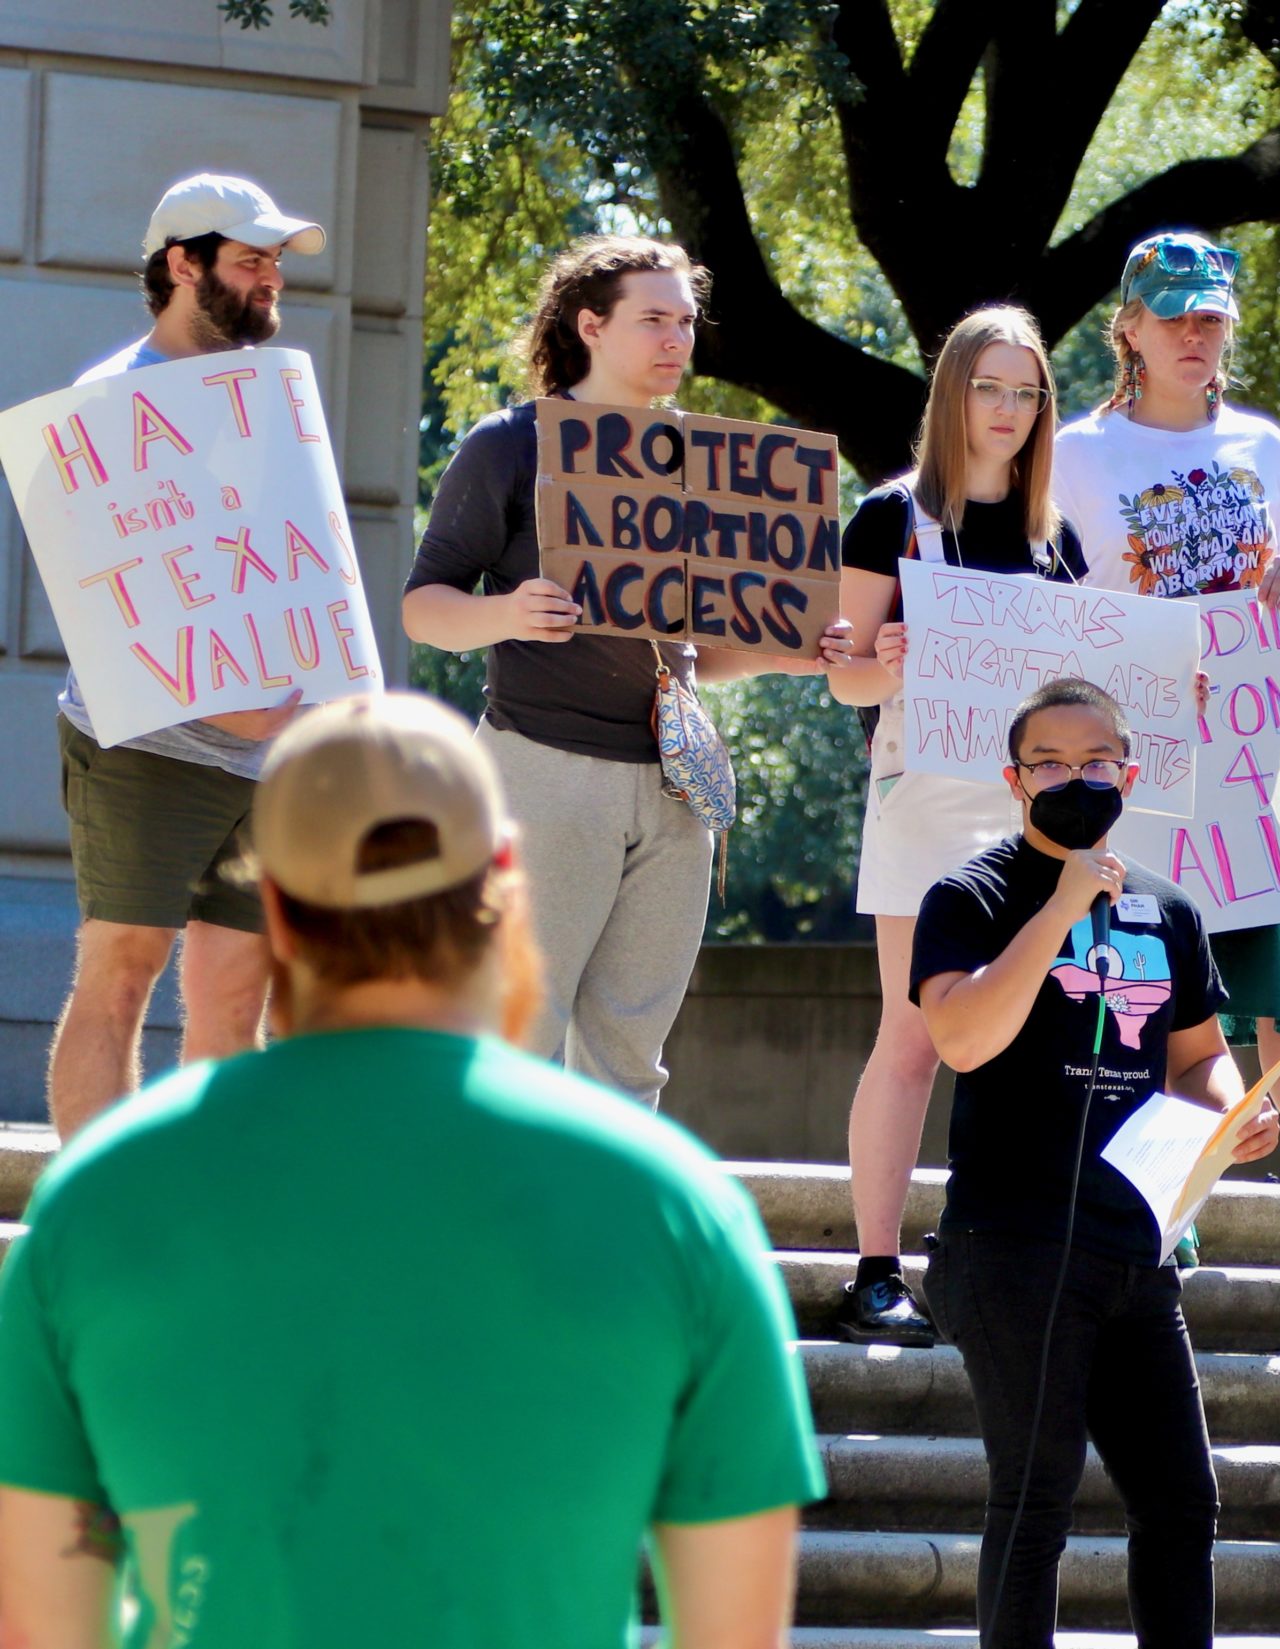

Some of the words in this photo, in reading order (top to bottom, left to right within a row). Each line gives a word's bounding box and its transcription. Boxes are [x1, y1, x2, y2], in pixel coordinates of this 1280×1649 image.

[41, 368, 321, 494] HATE
[559, 412, 836, 505] PROTECT
[107, 479, 195, 538] isn't
[220, 485, 242, 511] a
[565, 490, 841, 572] ABORTION
[1142, 521, 1188, 552] LOVES
[78, 511, 358, 629] TEXAS
[1149, 547, 1189, 575] WHO
[1197, 532, 1233, 560] HAD
[1240, 522, 1264, 546] AN
[1153, 550, 1259, 598] ABORTION
[572, 559, 809, 650] ACCESS
[932, 572, 1127, 648] TRANS
[1103, 663, 1181, 718] ARE
[913, 697, 1018, 763] HUM
[1220, 742, 1275, 810] 4
